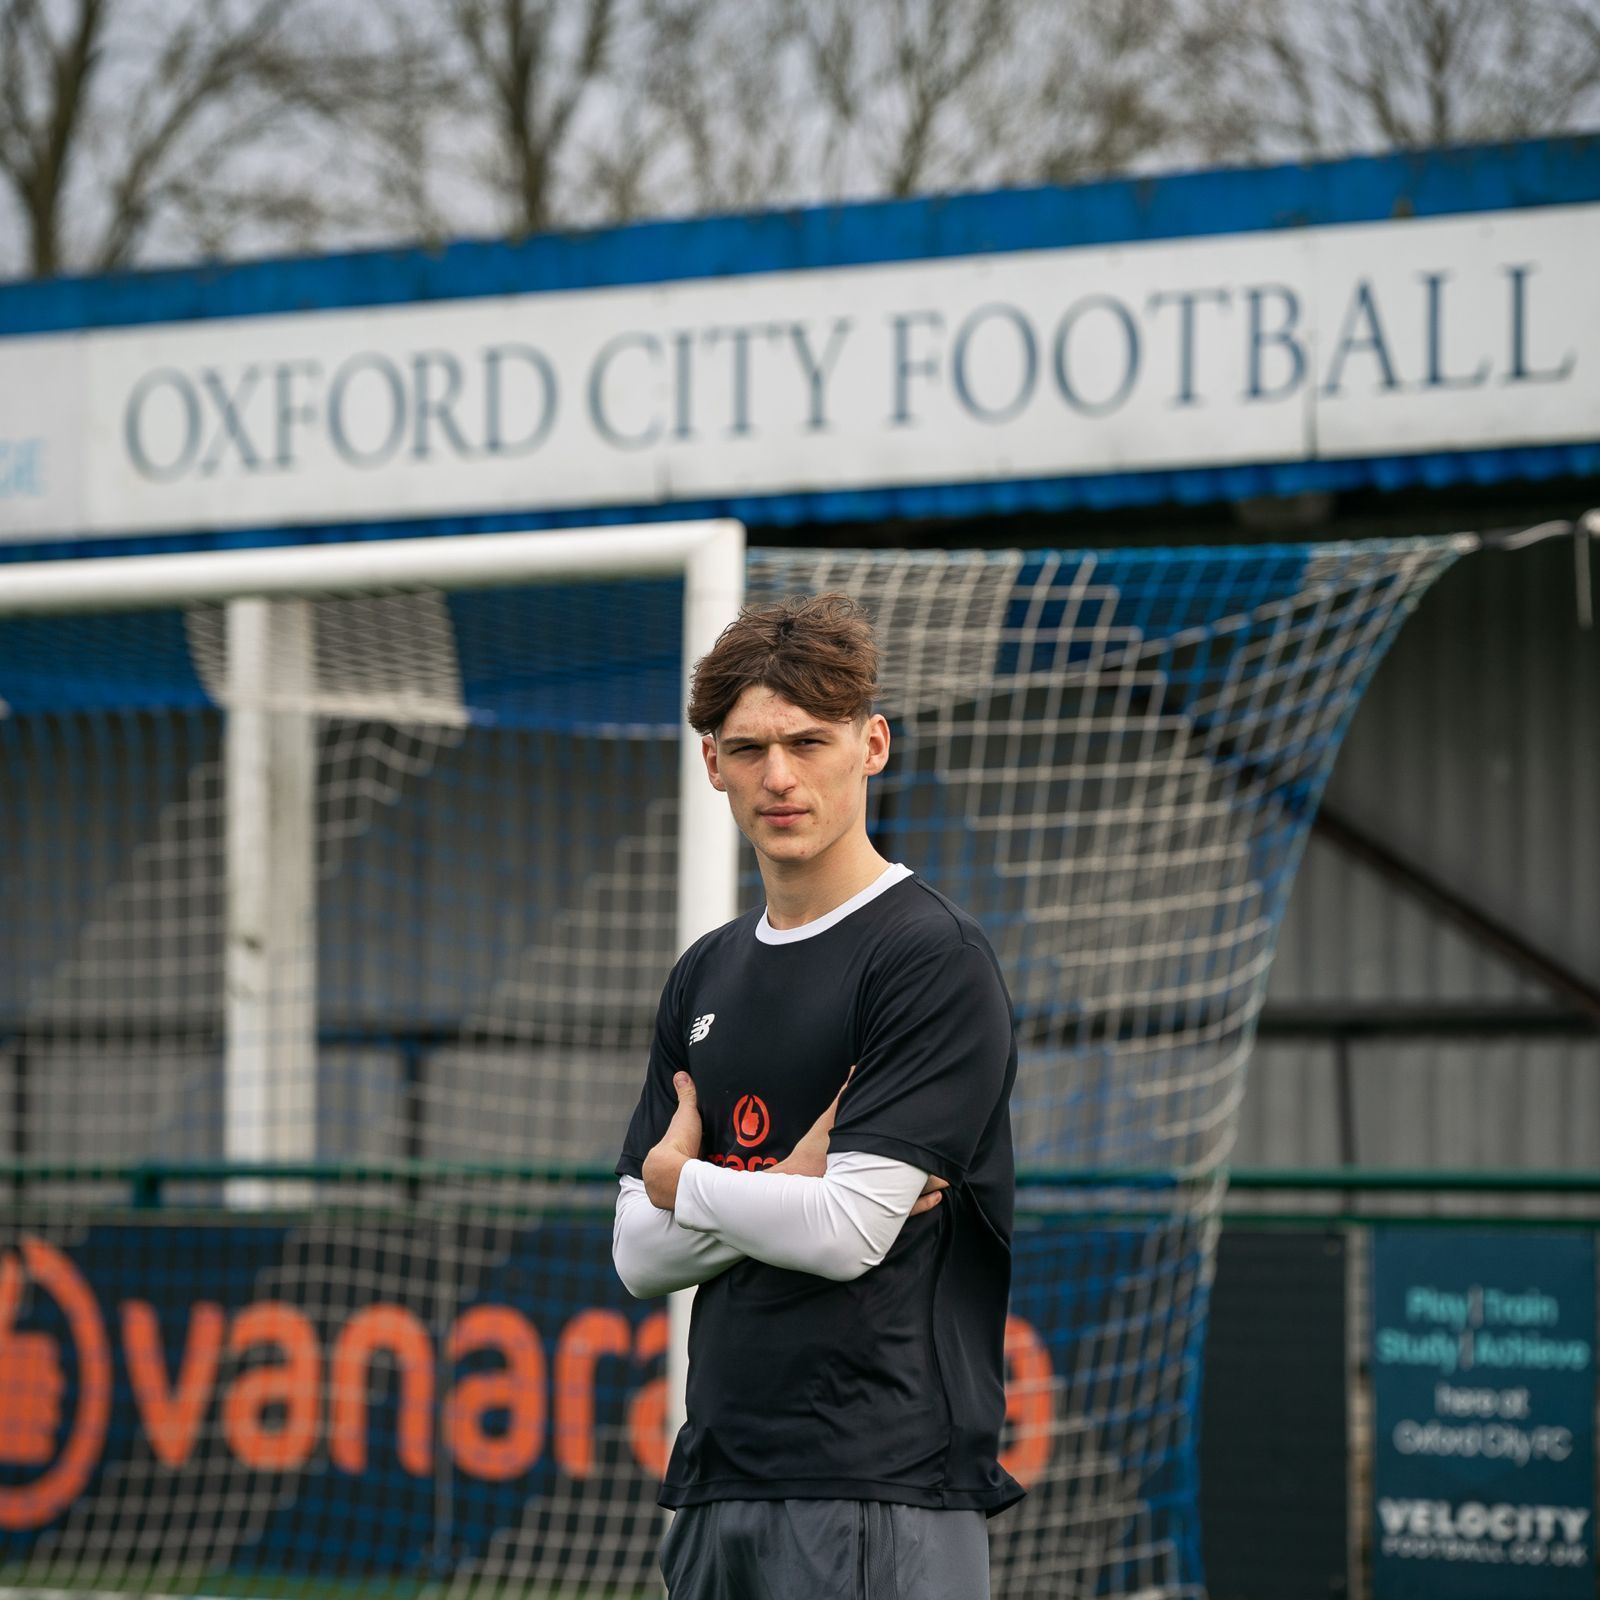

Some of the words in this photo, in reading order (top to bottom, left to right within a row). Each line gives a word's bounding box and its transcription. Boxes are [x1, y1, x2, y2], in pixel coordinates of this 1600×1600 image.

[123, 341, 558, 483] OXFORD
[587, 314, 852, 450] CITY
[890, 264, 1576, 427] FOOTBALL
[1378, 1498, 1589, 1542] VELOCITY
